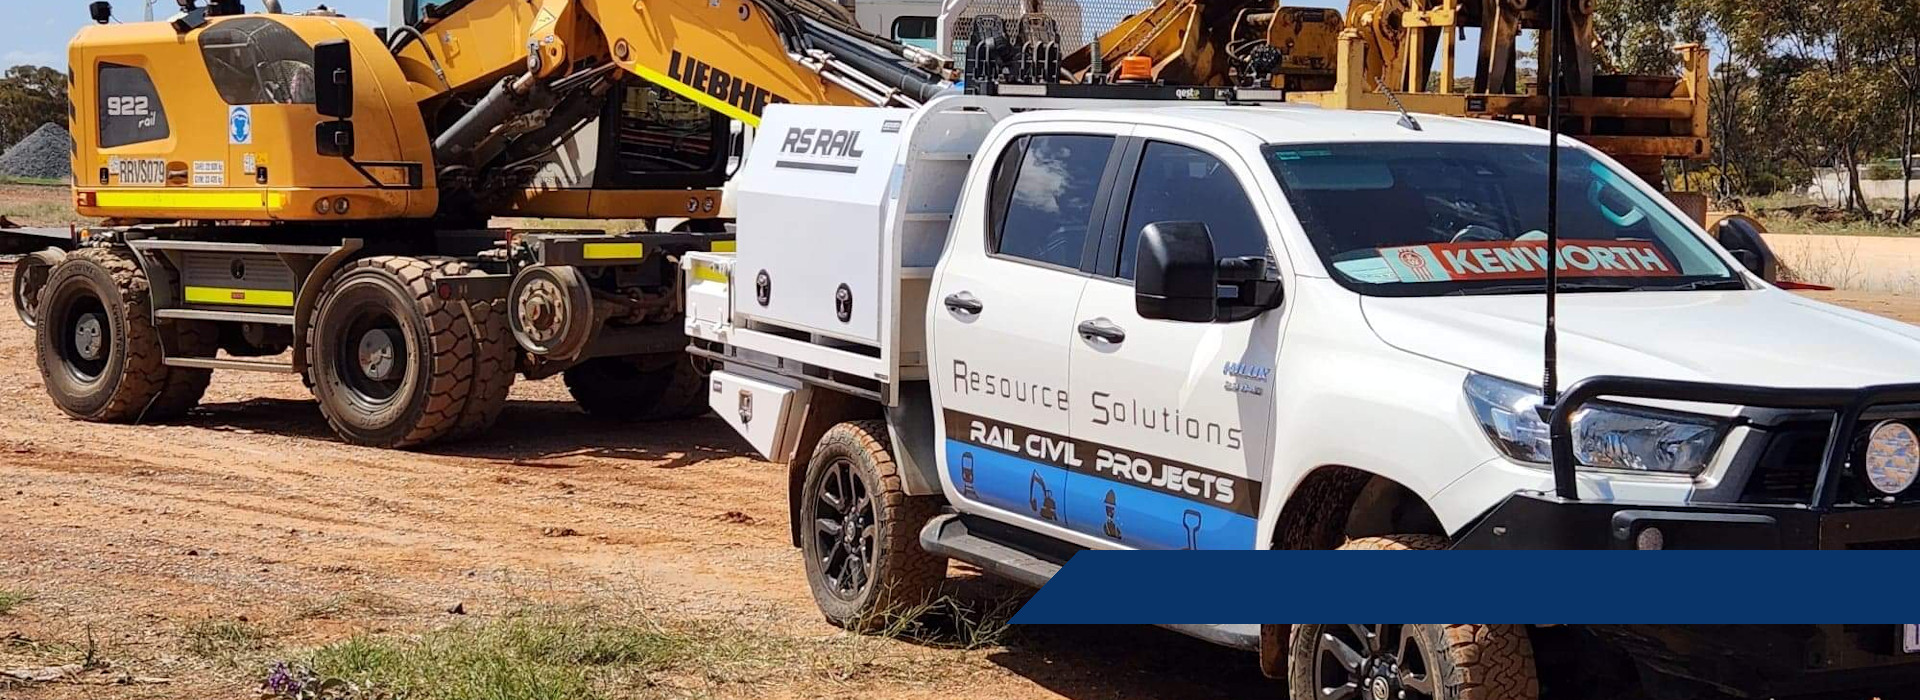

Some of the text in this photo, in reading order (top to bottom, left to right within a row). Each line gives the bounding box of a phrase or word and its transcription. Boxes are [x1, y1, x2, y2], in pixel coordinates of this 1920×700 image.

[668, 49, 790, 118] LIEBHE
[107, 96, 149, 115] 922
[138, 110, 156, 128] rail
[780, 127, 864, 158] RS RAIL
[119, 160, 165, 183] RRVS079
[1440, 244, 1669, 275] KENWORTH
[953, 359, 1243, 450] Resource Solutions
[969, 420, 1235, 504] RAIL CIVIL PROJECTS
